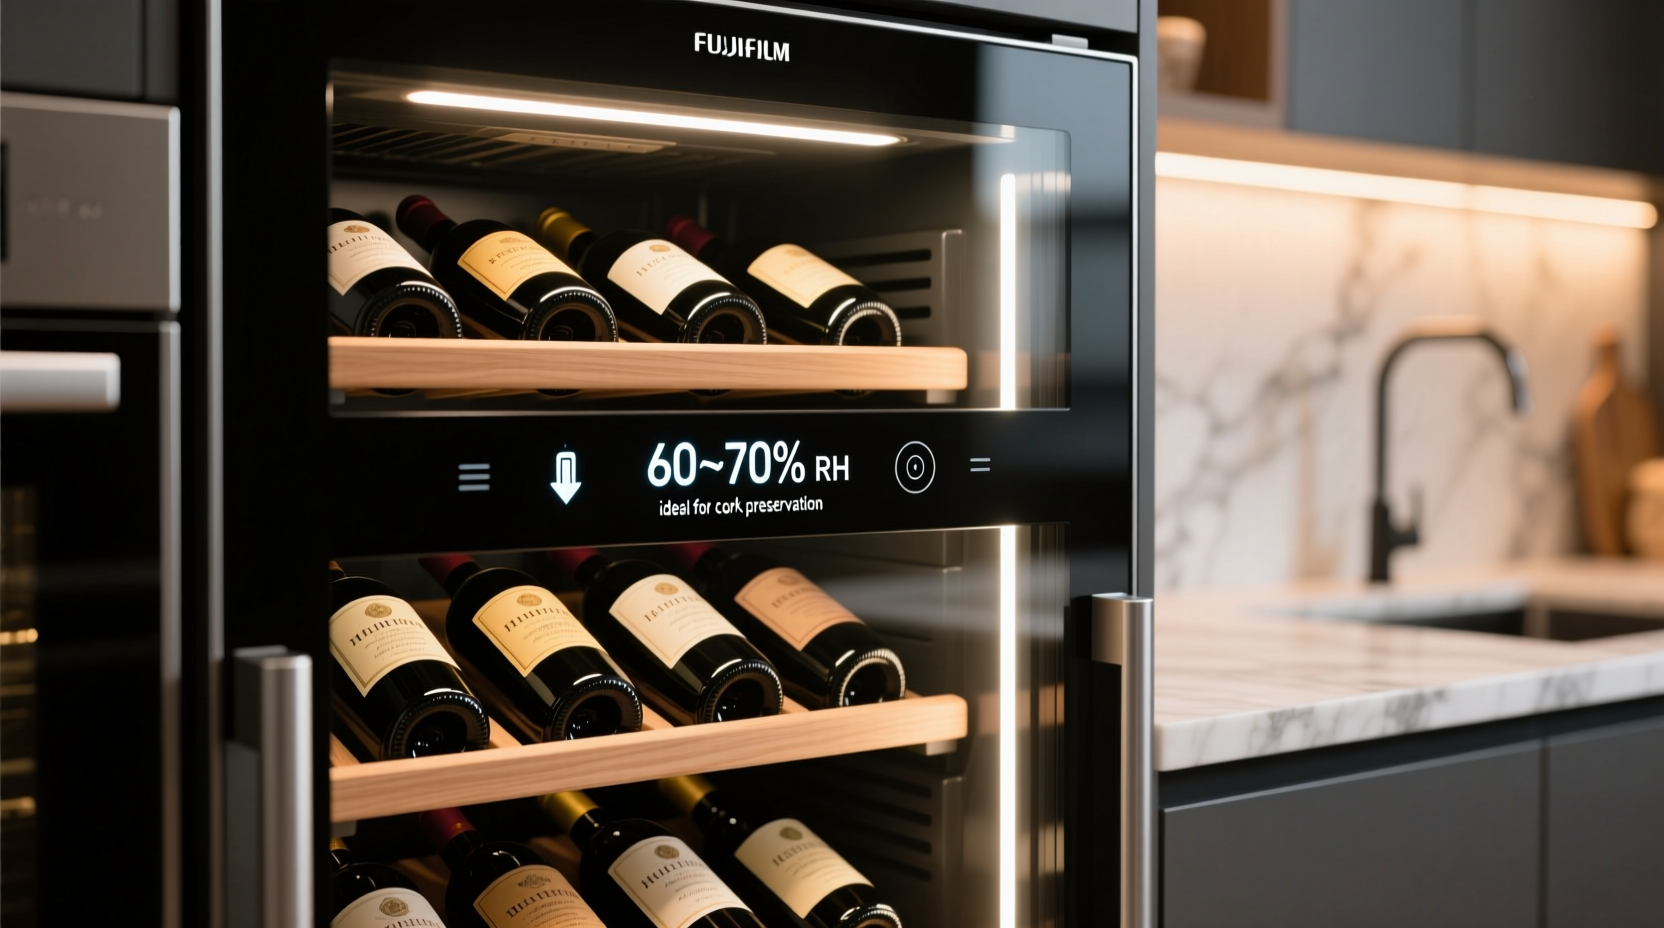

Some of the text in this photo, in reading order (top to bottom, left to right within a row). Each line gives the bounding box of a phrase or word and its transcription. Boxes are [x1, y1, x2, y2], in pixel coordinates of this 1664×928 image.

[694, 31, 790, 62] FUJIFILM
[647, 440, 850, 487] 60~70% RH
[659, 495, 824, 518] ideal for cork preservation
